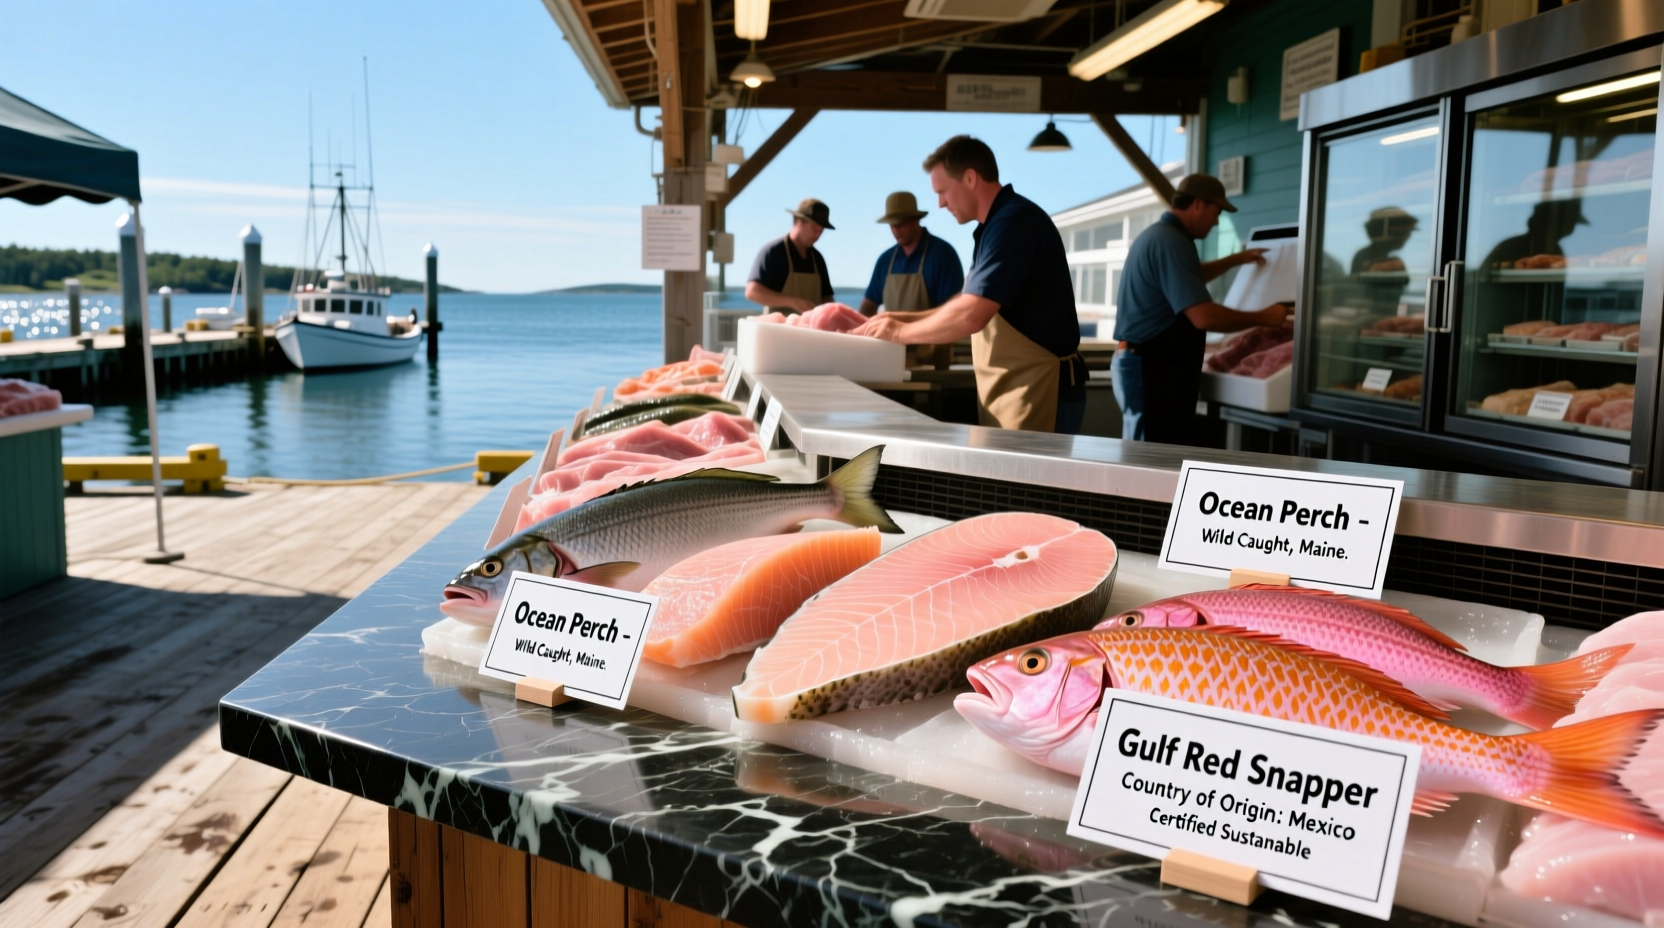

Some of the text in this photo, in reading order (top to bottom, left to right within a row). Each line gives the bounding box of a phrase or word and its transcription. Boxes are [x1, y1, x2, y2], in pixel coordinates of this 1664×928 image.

[1198, 491, 1274, 522] Ocean
[1279, 499, 1350, 531] Perch
[1202, 527, 1349, 560] Wild Caught, Maine.
[514, 600, 567, 633] Ocean
[568, 612, 619, 644] Perch
[575, 651, 606, 670] Maine.
[1118, 727, 1379, 809] Gulf Red Snapper
[1121, 771, 1356, 841] Country of Origin: Mexico
[1149, 807, 1312, 860] Certified Sustanable
